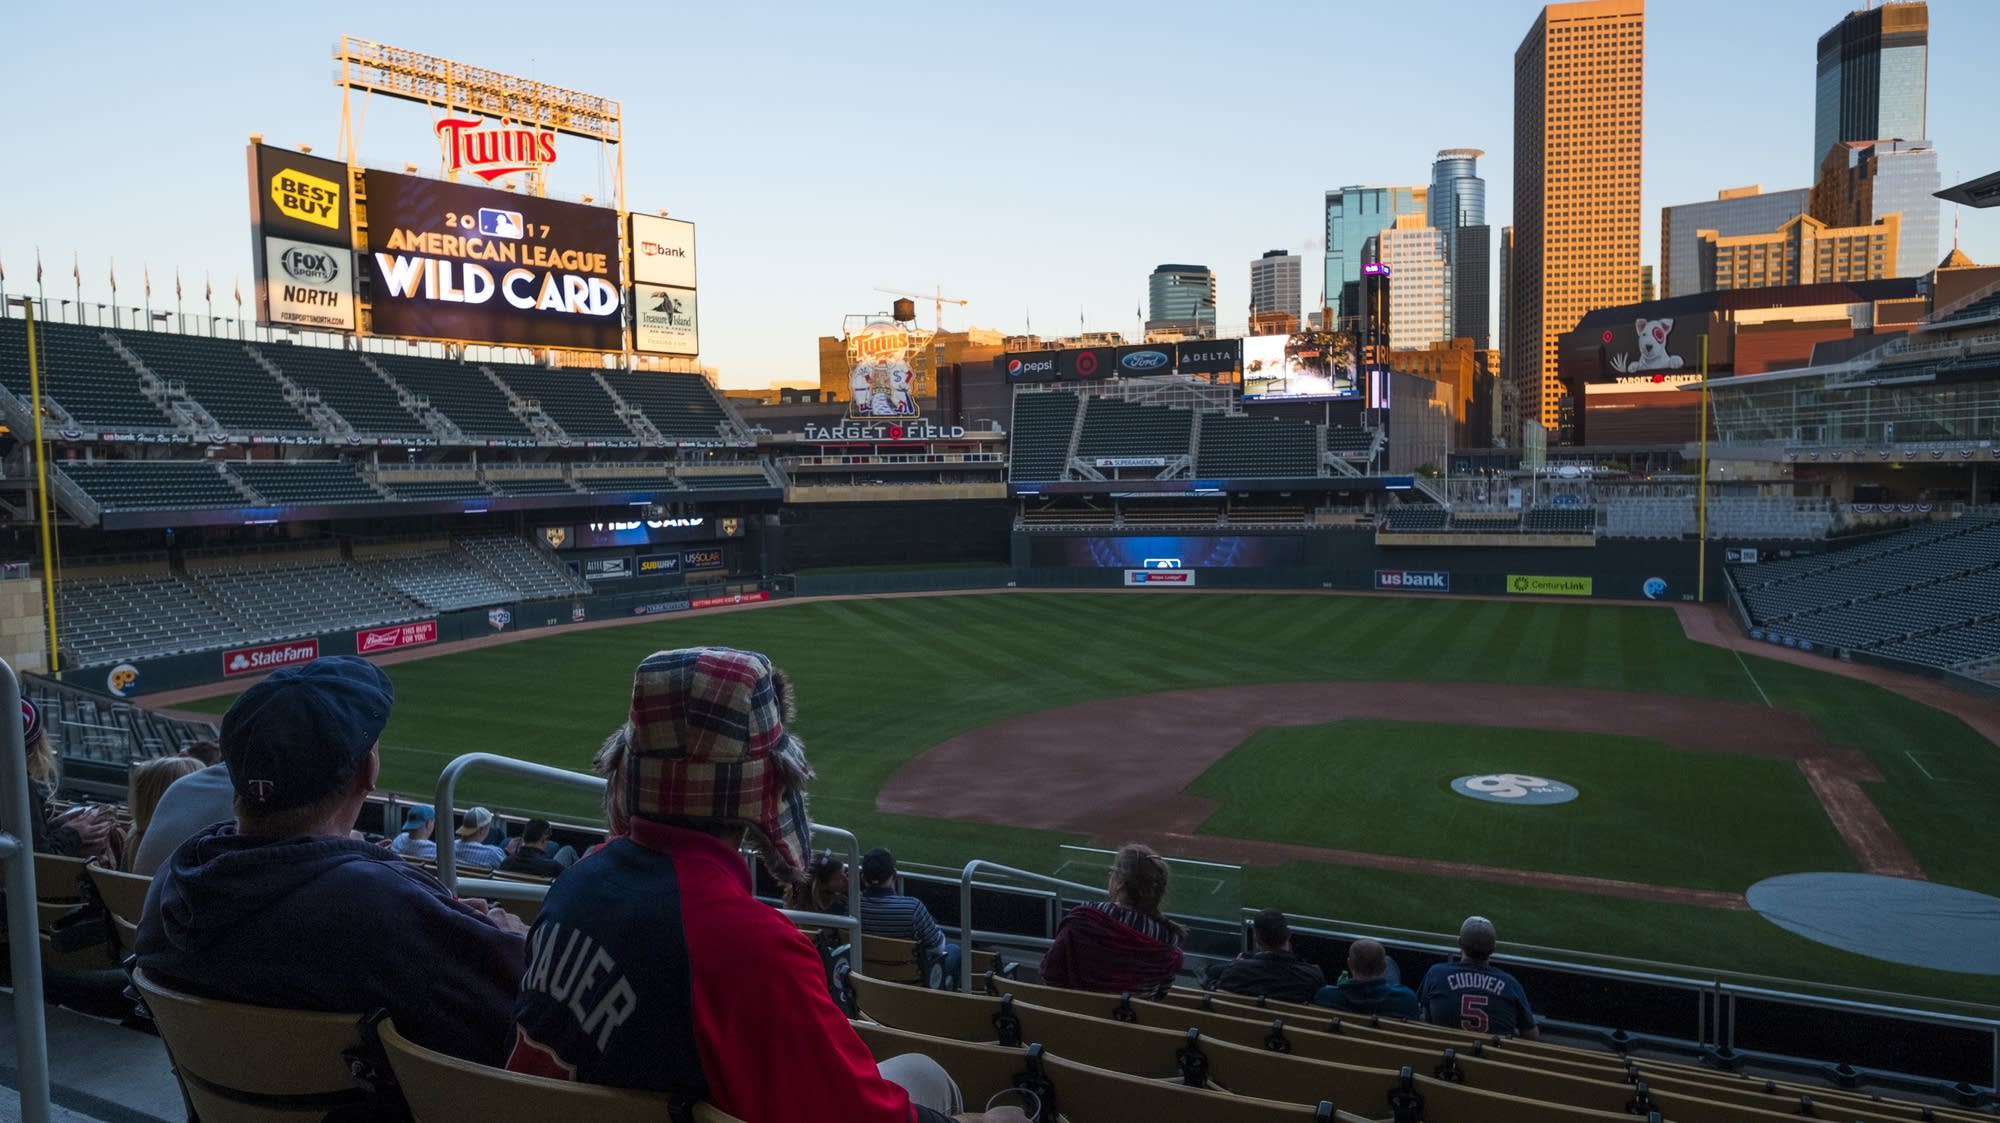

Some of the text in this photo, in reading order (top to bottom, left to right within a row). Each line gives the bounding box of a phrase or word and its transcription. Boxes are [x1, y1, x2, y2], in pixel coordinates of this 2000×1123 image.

[435, 117, 558, 182] Twins
[281, 177, 337, 205] BEST
[283, 193, 333, 219] BUY
[386, 227, 608, 275] AMERICAN LEAGUE
[293, 252, 326, 272] FOX
[293, 268, 328, 280] SPORTS
[374, 252, 620, 317] WILD CARD
[283, 285, 339, 307] NORTH
[281, 311, 344, 326] FOXSPORTSNORTH.COM
[643, 312, 691, 326] Treasure Island
[852, 332, 908, 358] Twins
[1131, 354, 1159, 367] Ford
[1193, 352, 1231, 362] DELTA
[1023, 360, 1053, 373] pepsi
[1616, 374, 1702, 384] TARGET CENTER
[805, 426, 965, 439] TARGET FIELD
[640, 558, 678, 571] SUBWAY
[1381, 572, 1444, 588] usbank
[1531, 580, 1585, 592] CenturyLink
[498, 612, 509, 623] 29
[402, 626, 415, 635] THIS
[402, 635, 413, 644] FOR
[1447, 972, 1505, 996] CUDDYER
[1461, 994, 1489, 1033] 5
